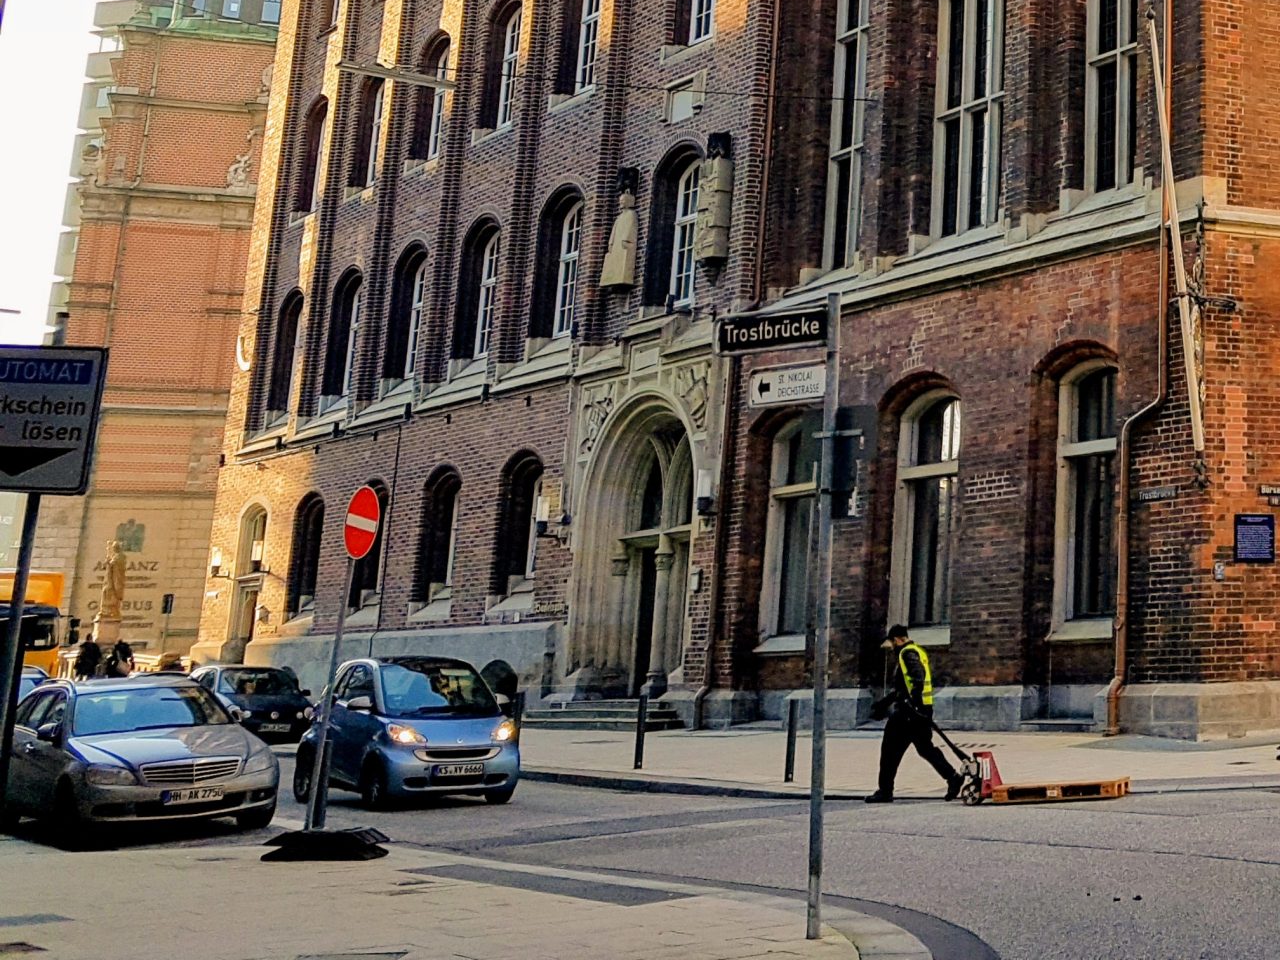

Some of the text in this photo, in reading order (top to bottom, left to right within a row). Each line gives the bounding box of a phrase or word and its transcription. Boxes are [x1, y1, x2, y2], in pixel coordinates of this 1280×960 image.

[724, 316, 820, 343] Trostbrücke
[788, 370, 813, 383] NIKOLAI
[777, 382, 820, 398] DEICHSTRASSE
[0, 394, 86, 416] kschein
[21, 420, 81, 441] lösen
[169, 791, 182, 801] HH
[188, 789, 200, 800] AK
